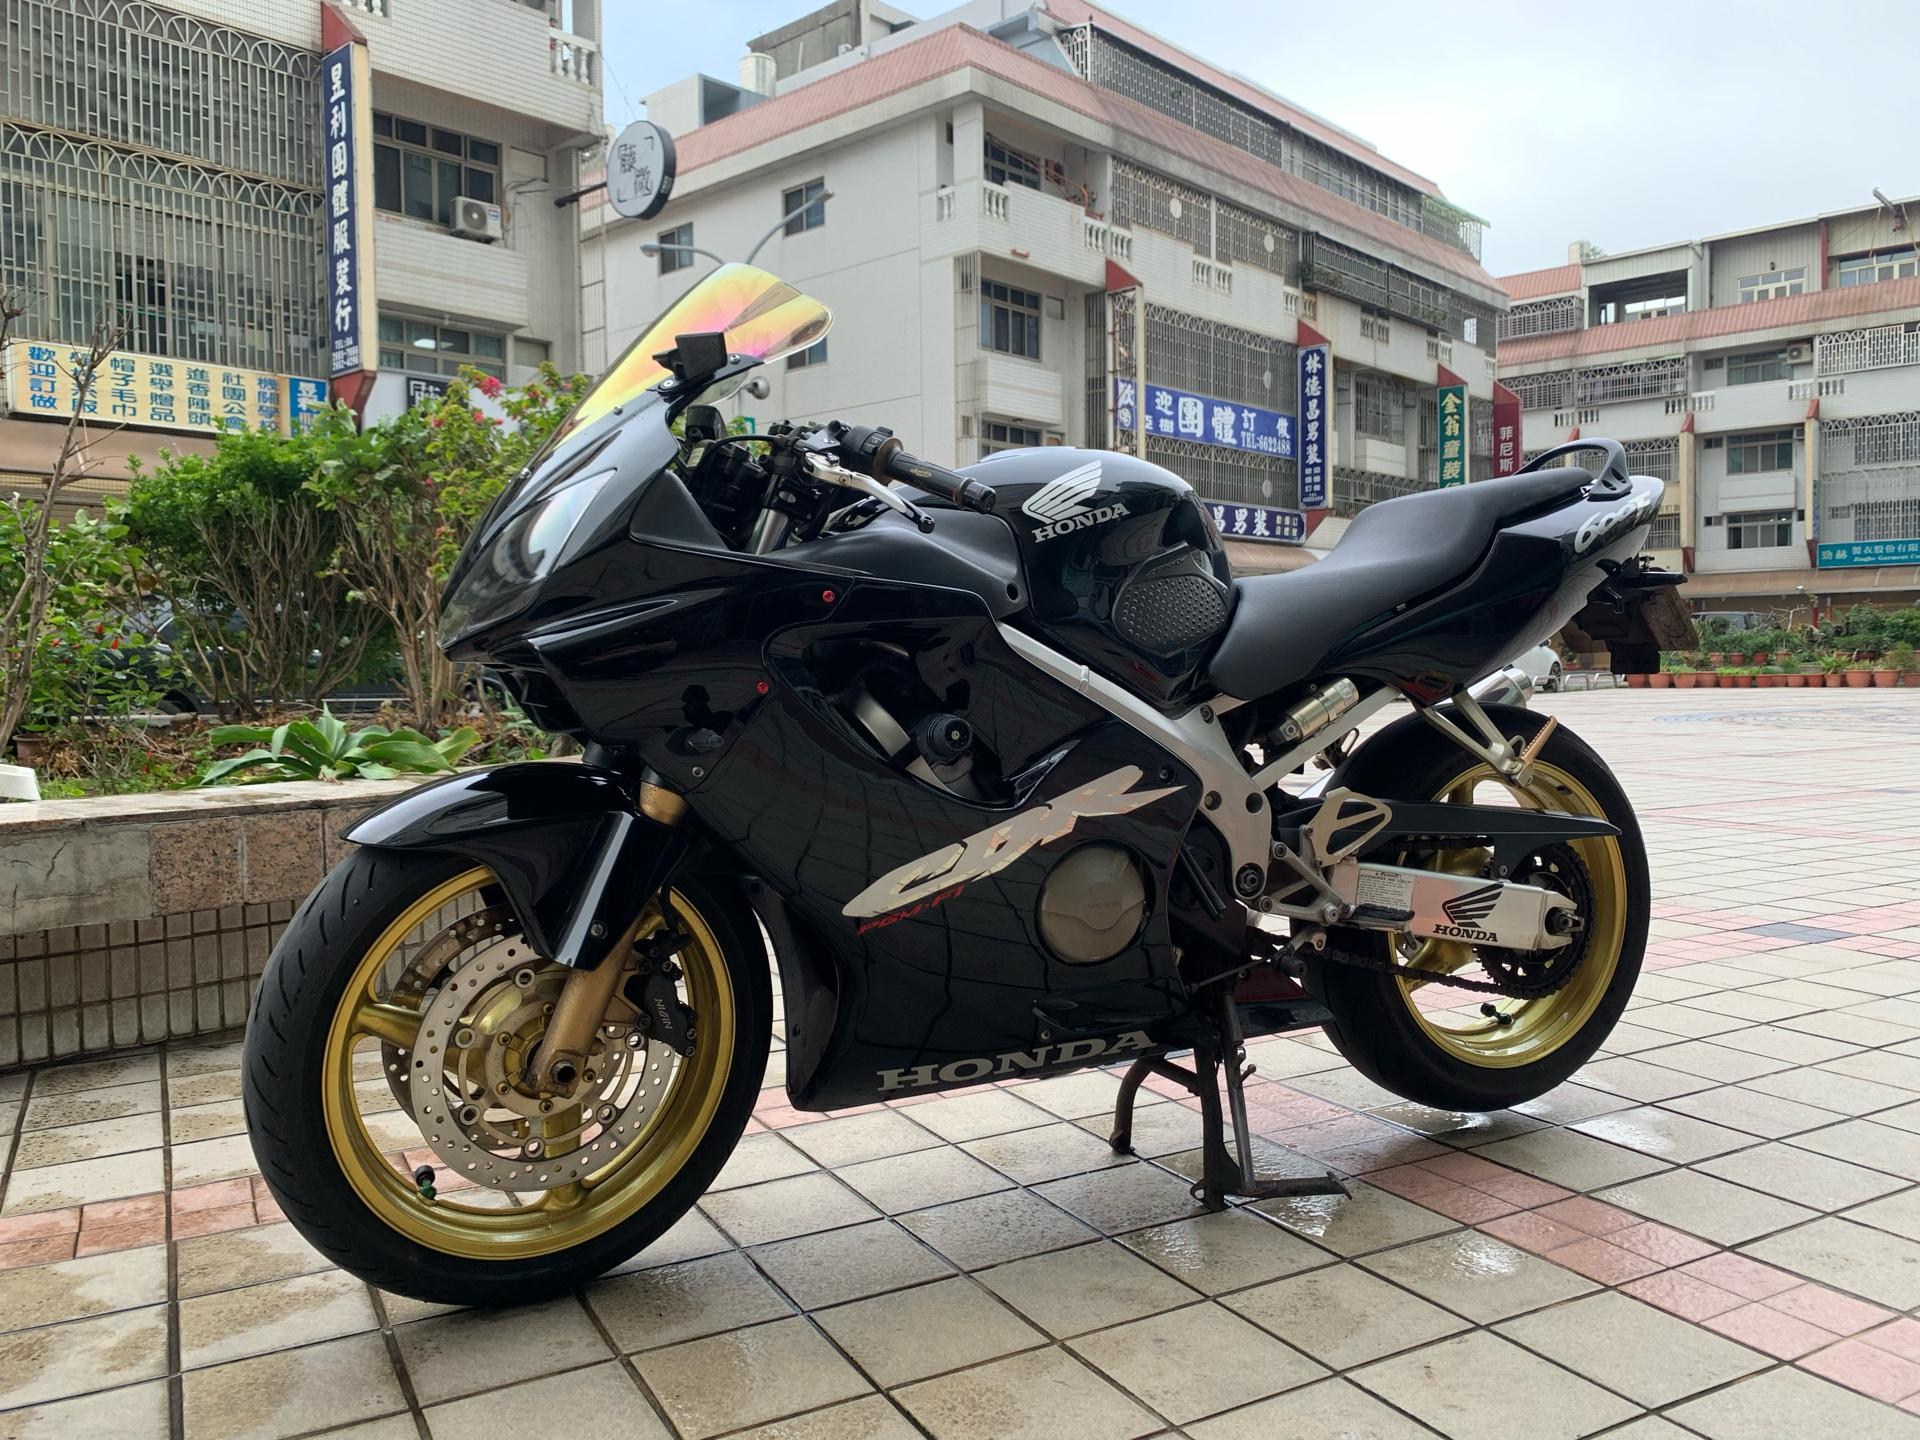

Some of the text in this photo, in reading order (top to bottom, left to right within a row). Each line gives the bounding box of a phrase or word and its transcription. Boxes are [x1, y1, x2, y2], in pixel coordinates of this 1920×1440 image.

[28, 346, 57, 410] 歡迎訂做
[110, 357, 137, 416] 帽子毛巾
[149, 362, 175, 422] 選舉贈品
[186, 367, 211, 425] 進香陣頭
[222, 372, 246, 429] 社團公會
[1305, 353, 1322, 465] 林德昌男裝
[1240, 431, 1291, 455] TEL:6622488
[1499, 426, 1514, 473] 菲尼斯
[1031, 503, 1131, 543] HONDA
[858, 883, 965, 936] PGM-FI
[1432, 923, 1499, 943] HONDA
[875, 1030, 1159, 1092] HONDA
